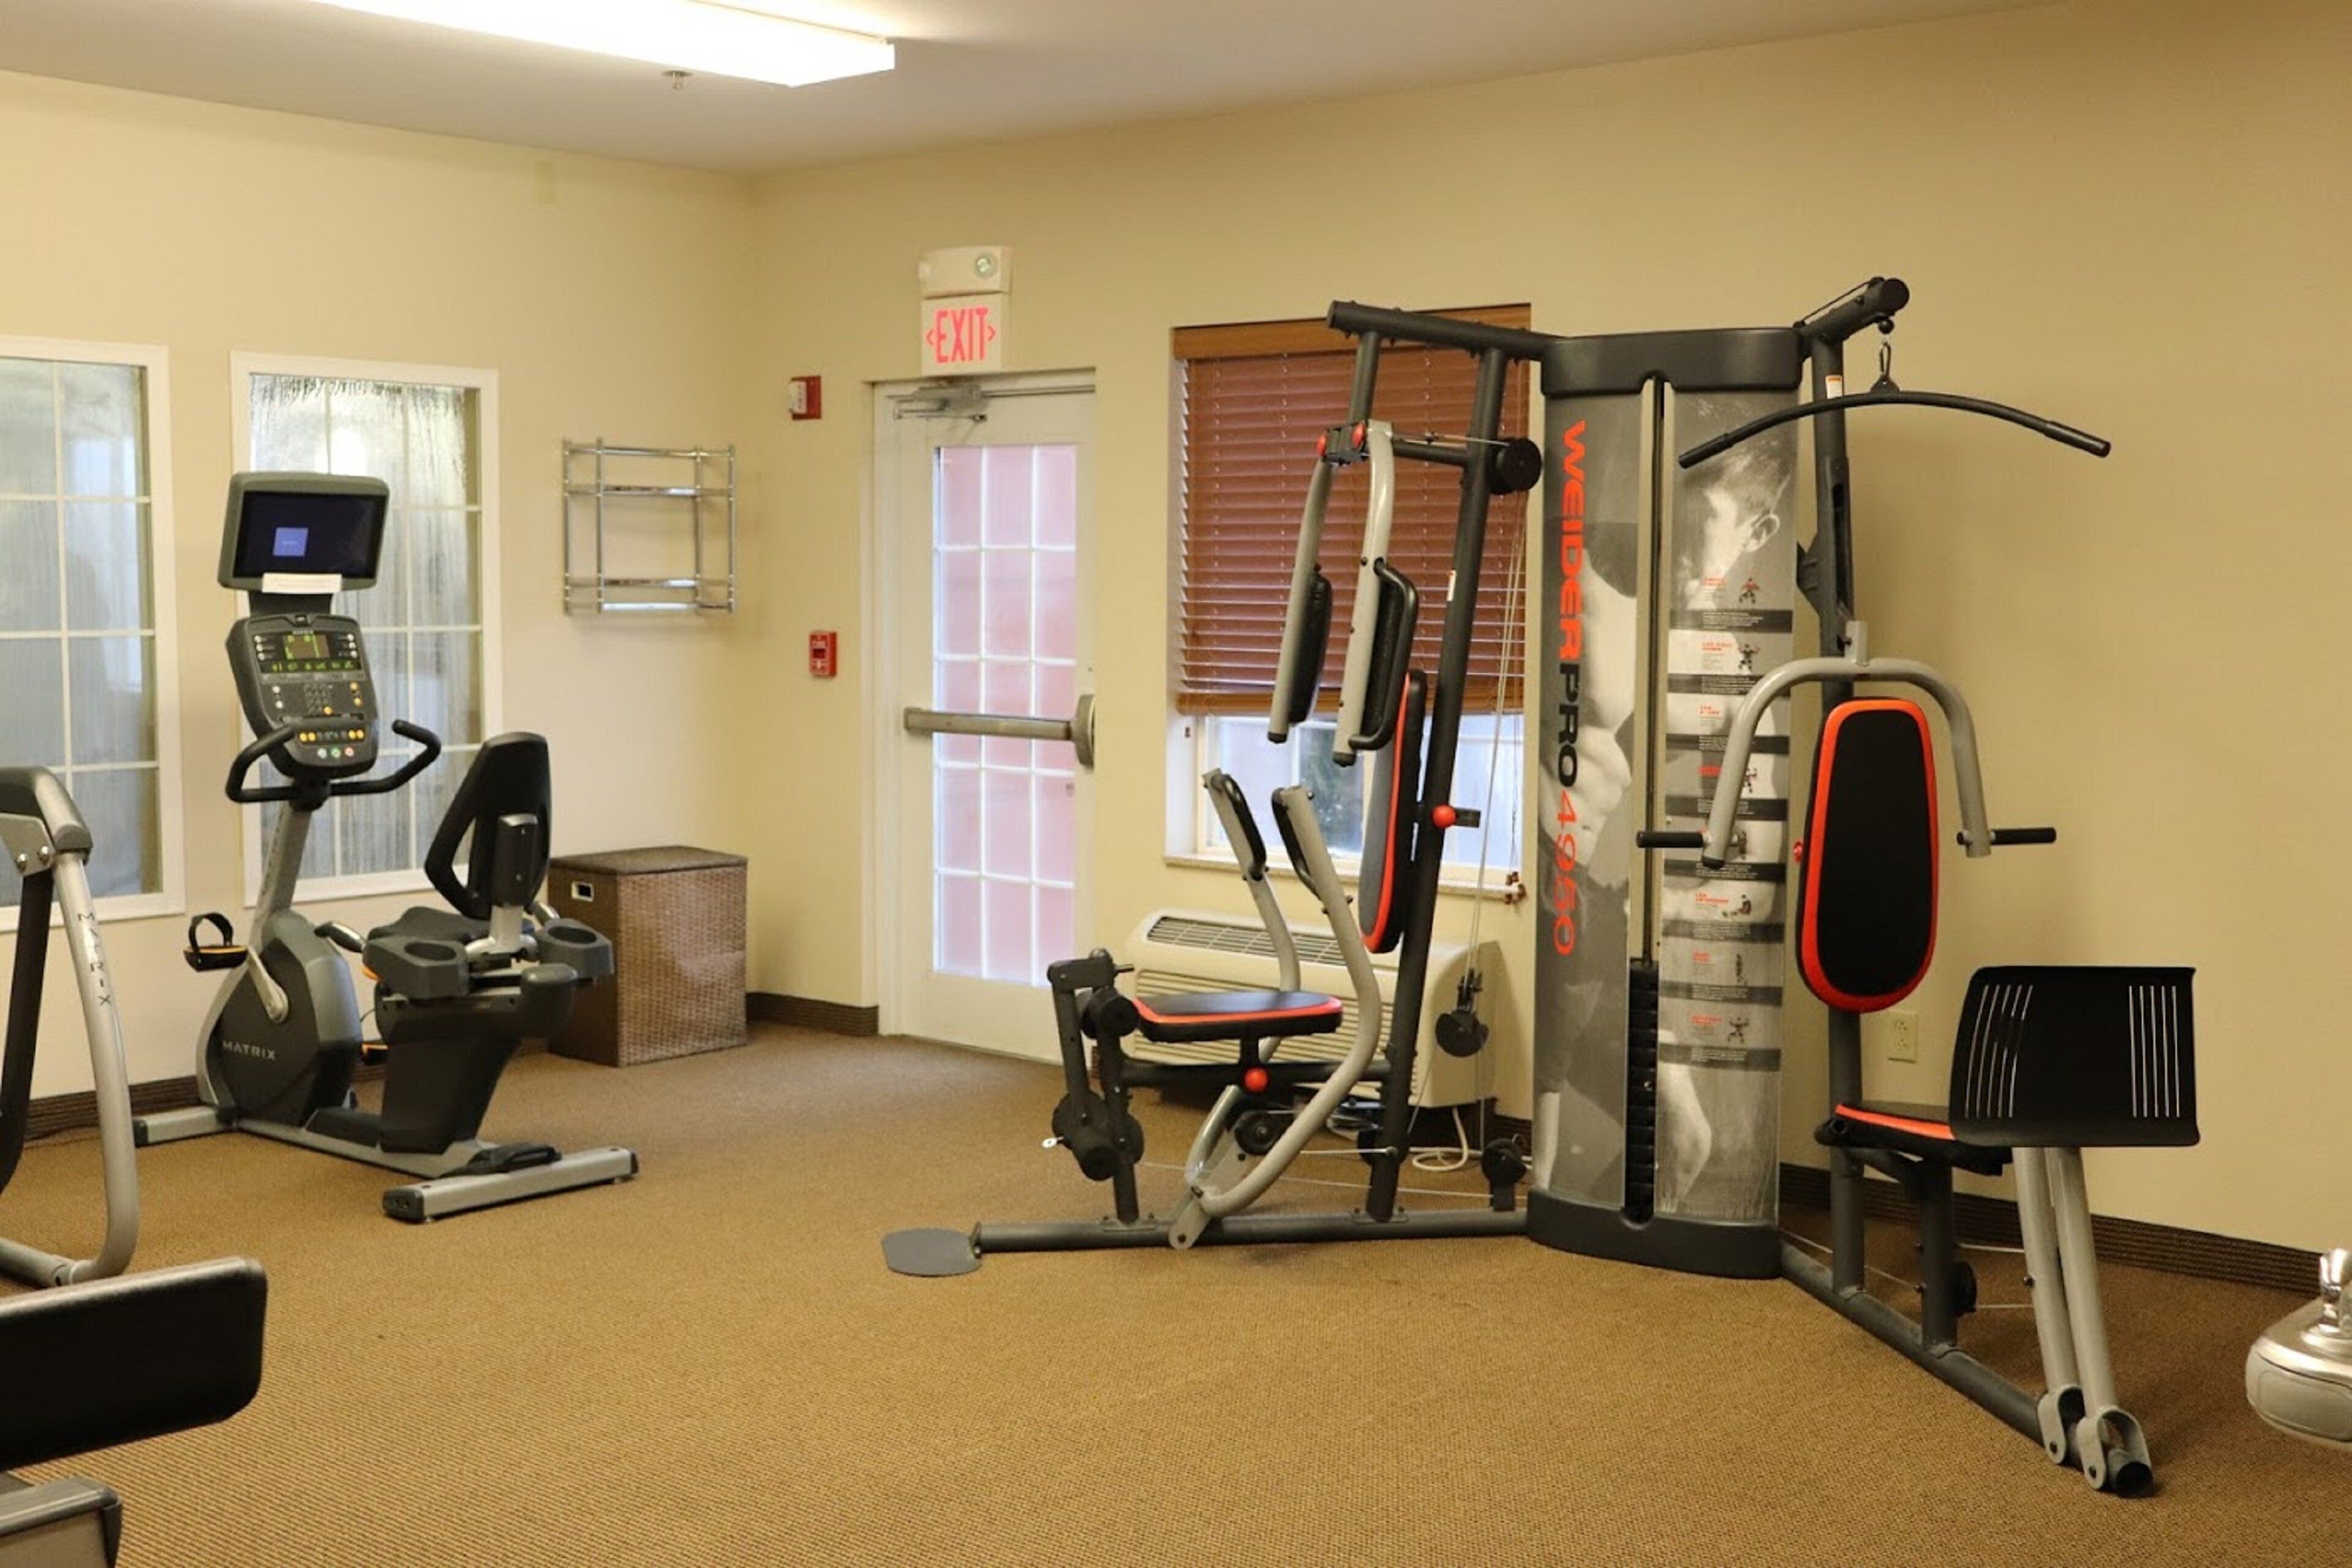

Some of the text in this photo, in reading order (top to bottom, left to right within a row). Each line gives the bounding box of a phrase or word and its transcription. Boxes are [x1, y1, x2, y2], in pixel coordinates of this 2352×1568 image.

[936, 307, 988, 363] EXIT
[1553, 419, 1586, 956] WEIDER PRO 4950
[222, 1040, 276, 1060] MATRIX
